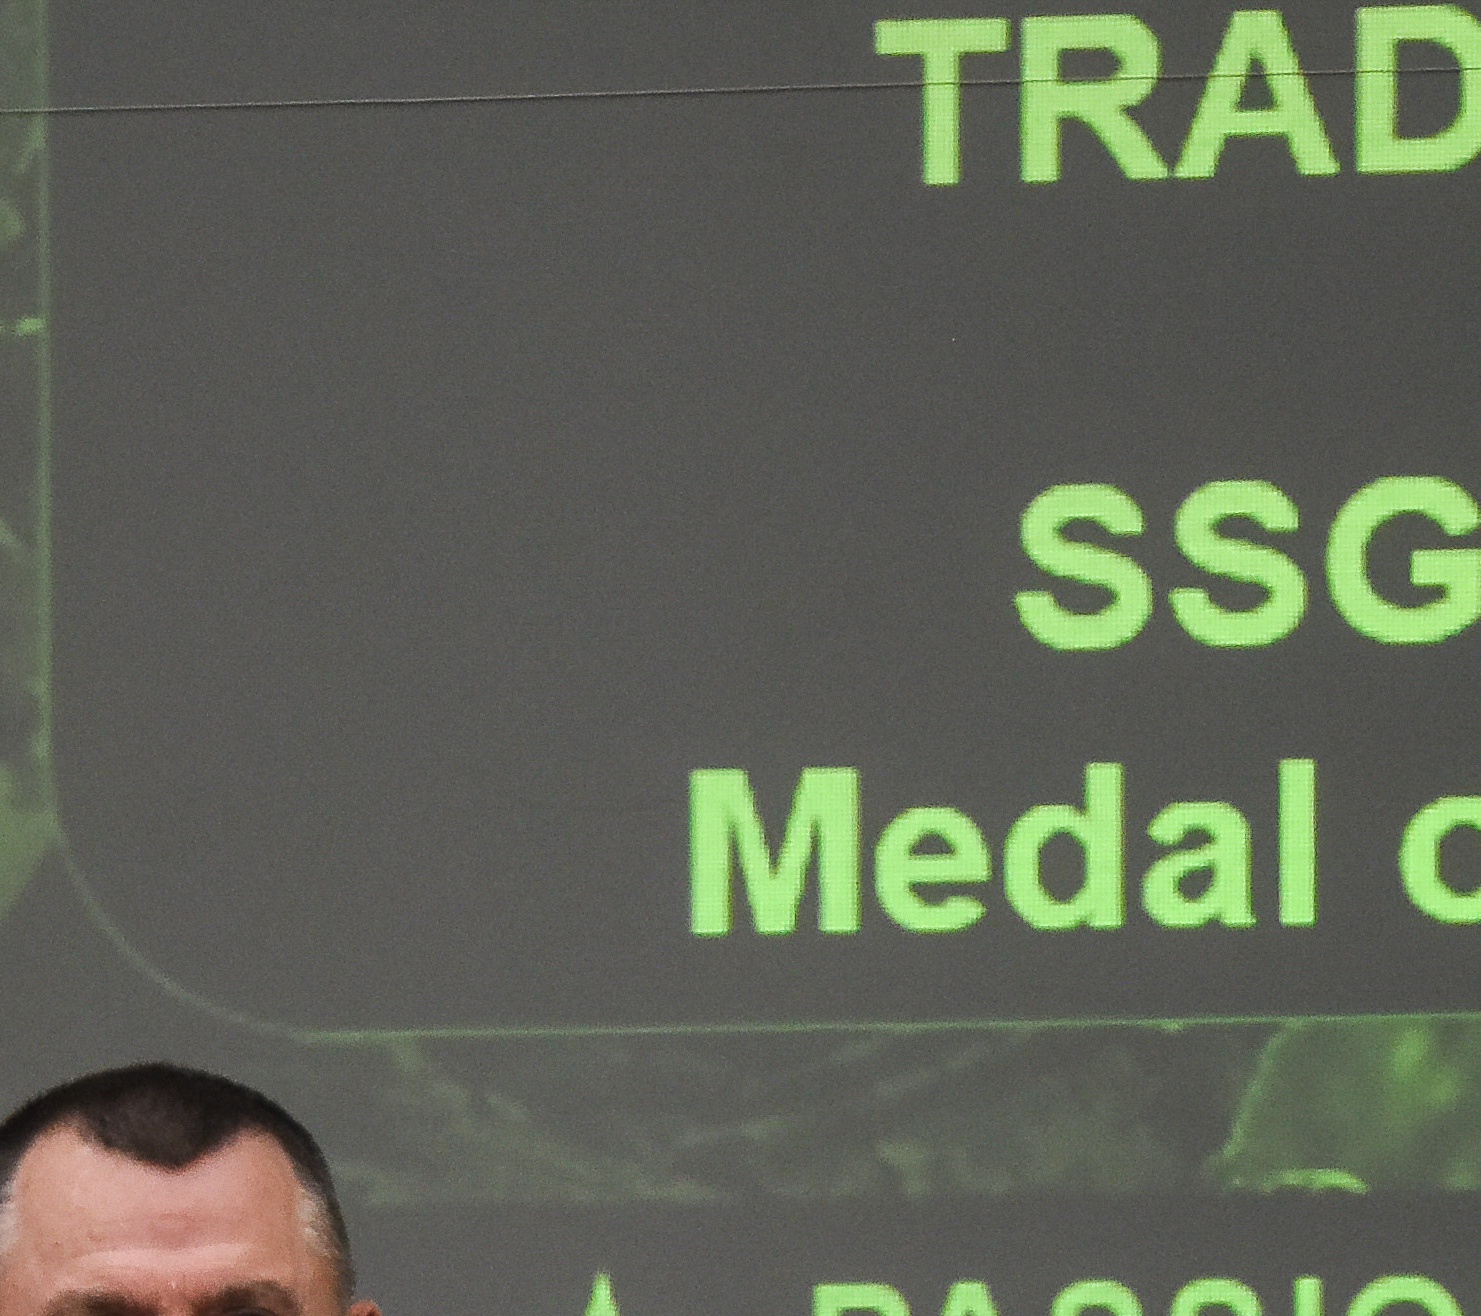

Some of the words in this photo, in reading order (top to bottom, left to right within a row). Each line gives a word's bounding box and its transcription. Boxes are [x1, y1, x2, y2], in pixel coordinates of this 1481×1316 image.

[874, 4, 1481, 186] TRAD
[1013, 475, 1481, 651] SSG
[689, 757, 1318, 936] Medal
